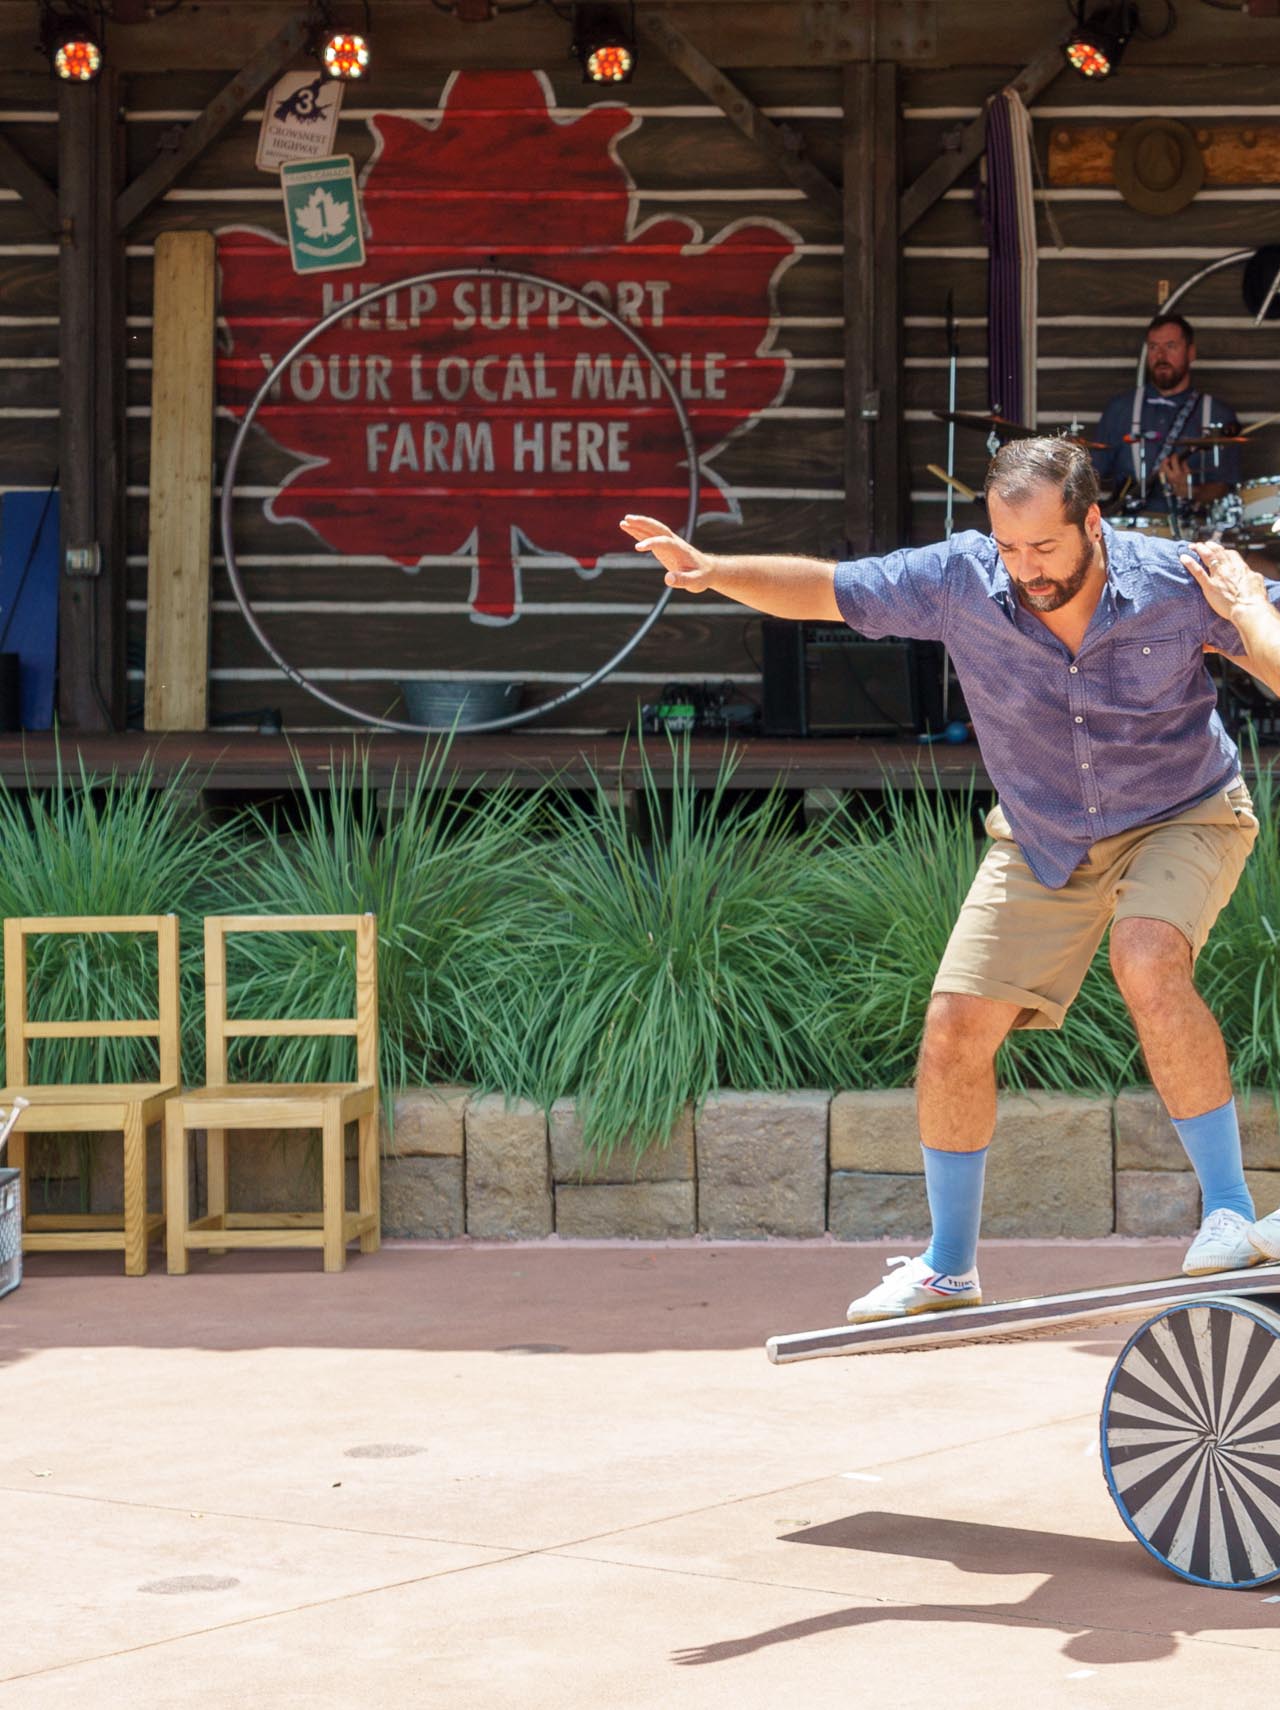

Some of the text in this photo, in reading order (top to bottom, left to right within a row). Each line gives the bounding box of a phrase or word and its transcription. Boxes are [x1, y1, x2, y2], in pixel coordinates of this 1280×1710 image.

[296, 89, 315, 115] 3
[272, 138, 320, 155] HIGHWAY
[316, 202, 328, 227] 1
[322, 280, 671, 330] HELP SUPPORT
[410, 353, 557, 401] LOCAL
[571, 353, 727, 400] MAPLE
[365, 421, 631, 473] FARM HERE
